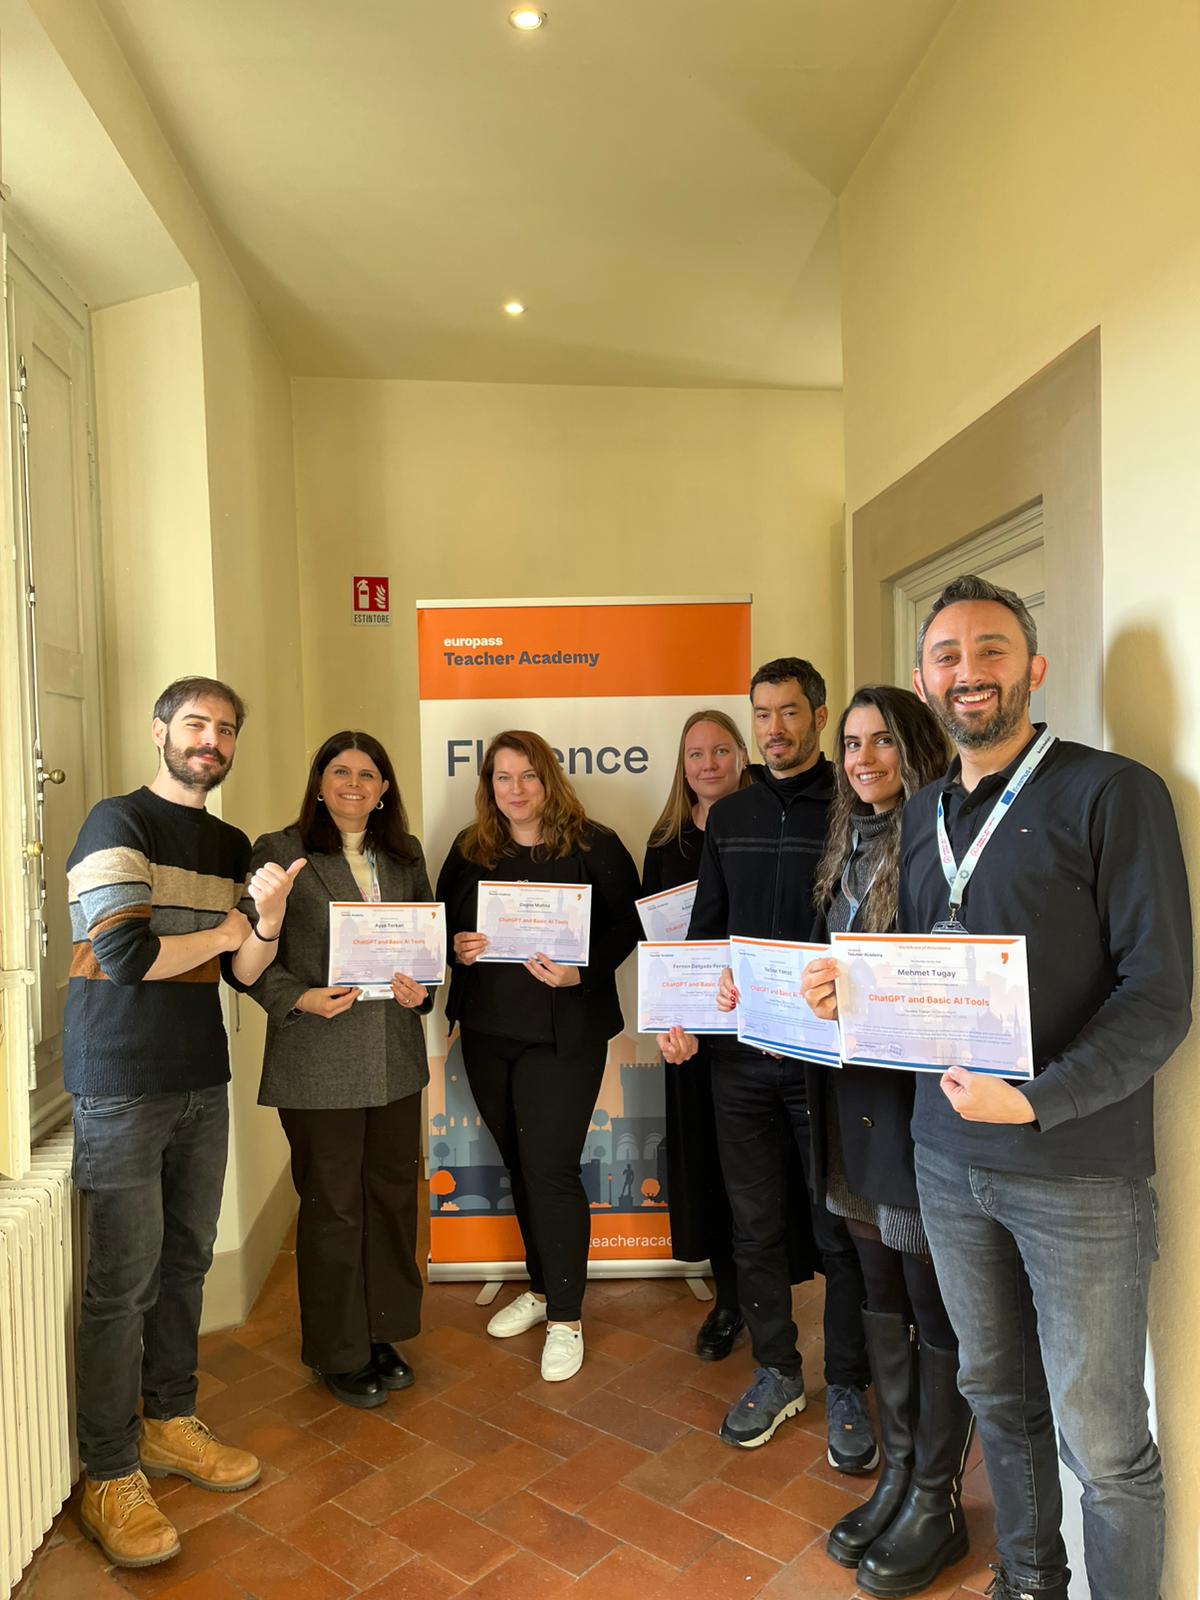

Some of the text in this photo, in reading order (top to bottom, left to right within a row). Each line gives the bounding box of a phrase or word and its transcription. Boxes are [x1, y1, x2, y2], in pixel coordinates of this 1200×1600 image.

[354, 614, 390, 624] ESTINTORE
[443, 636, 503, 648] europass
[443, 650, 600, 667] Teacher Academy
[447, 739, 649, 777] Flnce
[897, 969, 956, 978] Mehmet Tugay
[868, 993, 990, 1007] ChatGPT and Basic AI Tools
[589, 1233, 672, 1248] eacheraca
